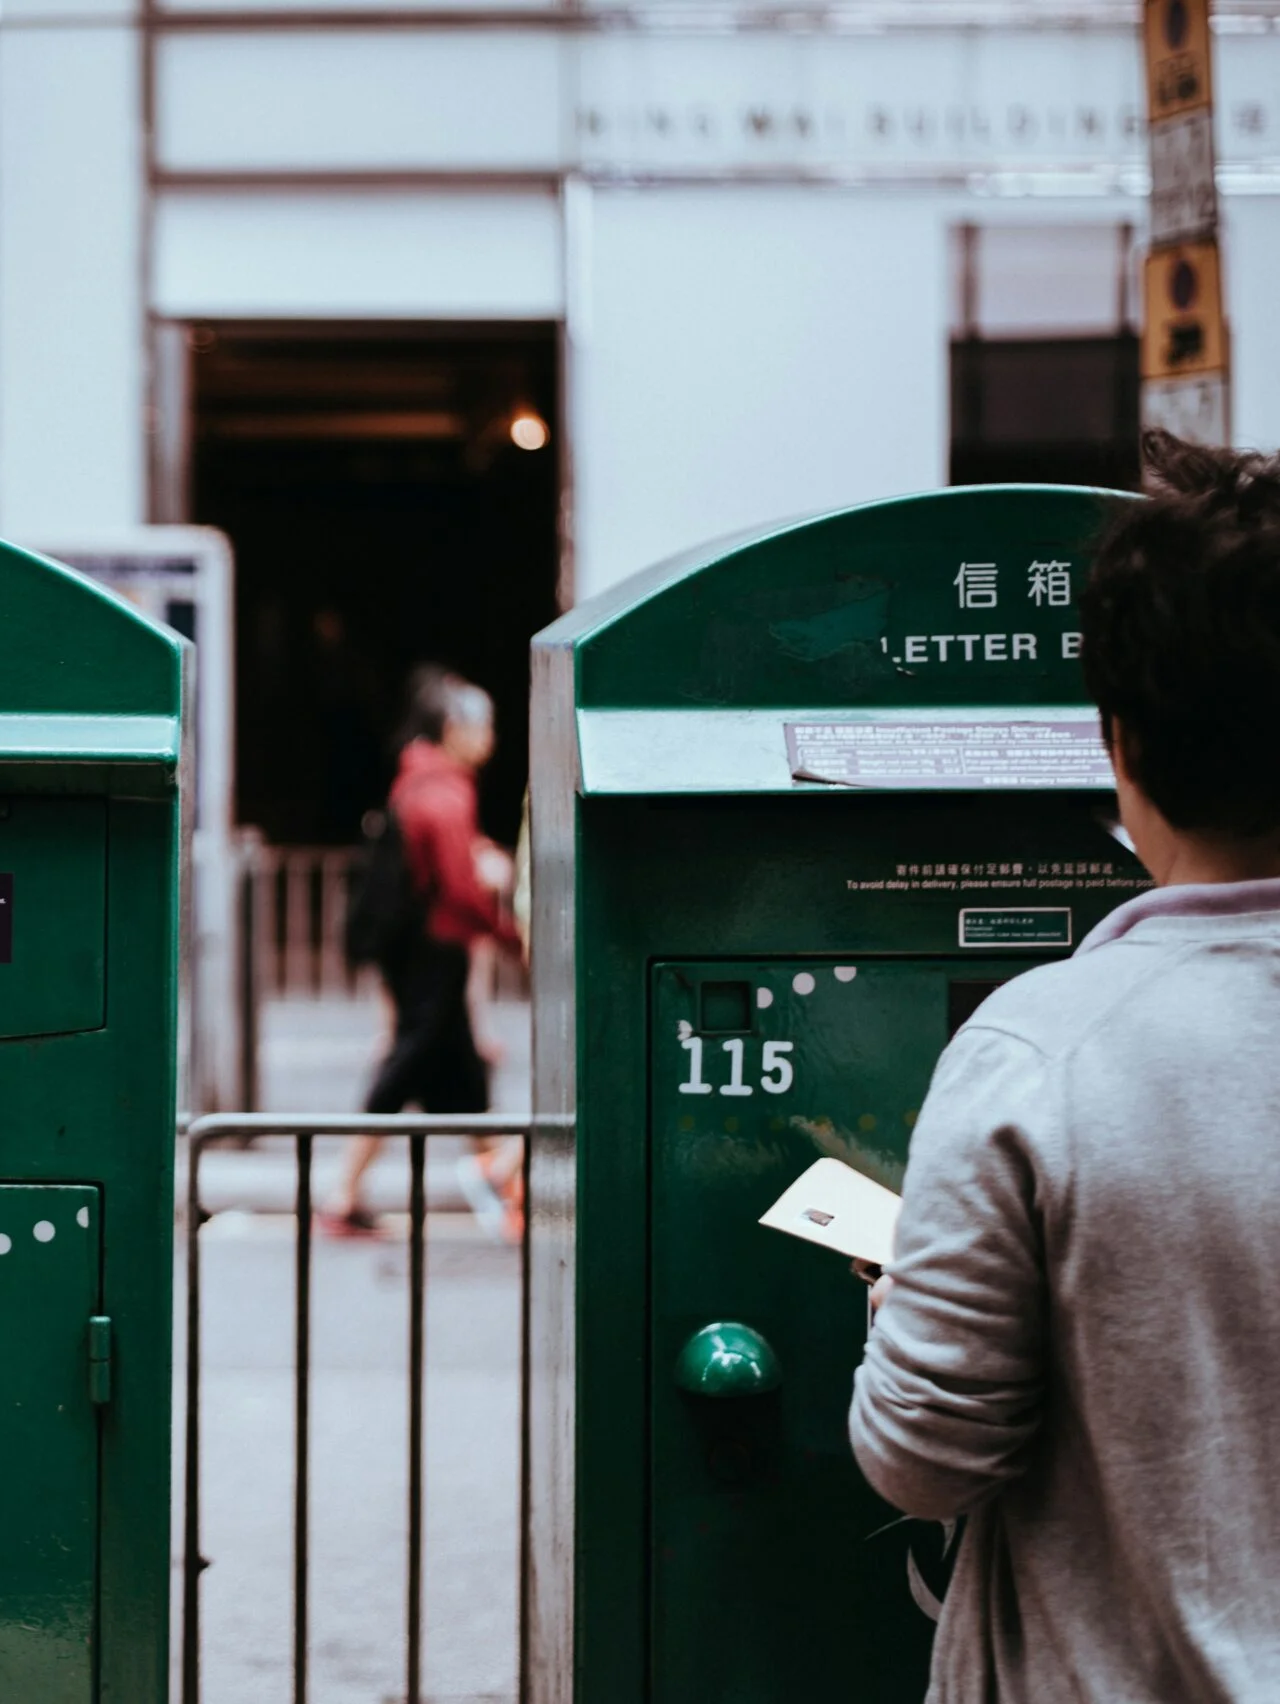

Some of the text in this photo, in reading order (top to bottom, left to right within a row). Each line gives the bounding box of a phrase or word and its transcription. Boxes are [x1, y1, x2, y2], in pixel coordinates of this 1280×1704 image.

[953, 560, 1072, 608] 信箱
[847, 879, 858, 889] To
[859, 880, 884, 889] avoid
[885, 880, 909, 890] delay
[911, 880, 919, 888] in
[960, 880, 989, 890] please
[991, 880, 1021, 888] ensure
[1022, 878, 1037, 887] full
[1039, 879, 1074, 889] postage
[1075, 879, 1083, 887] is
[1085, 879, 1105, 889] paid
[1106, 879, 1134, 887] before
[678, 1036, 794, 1096] 115
